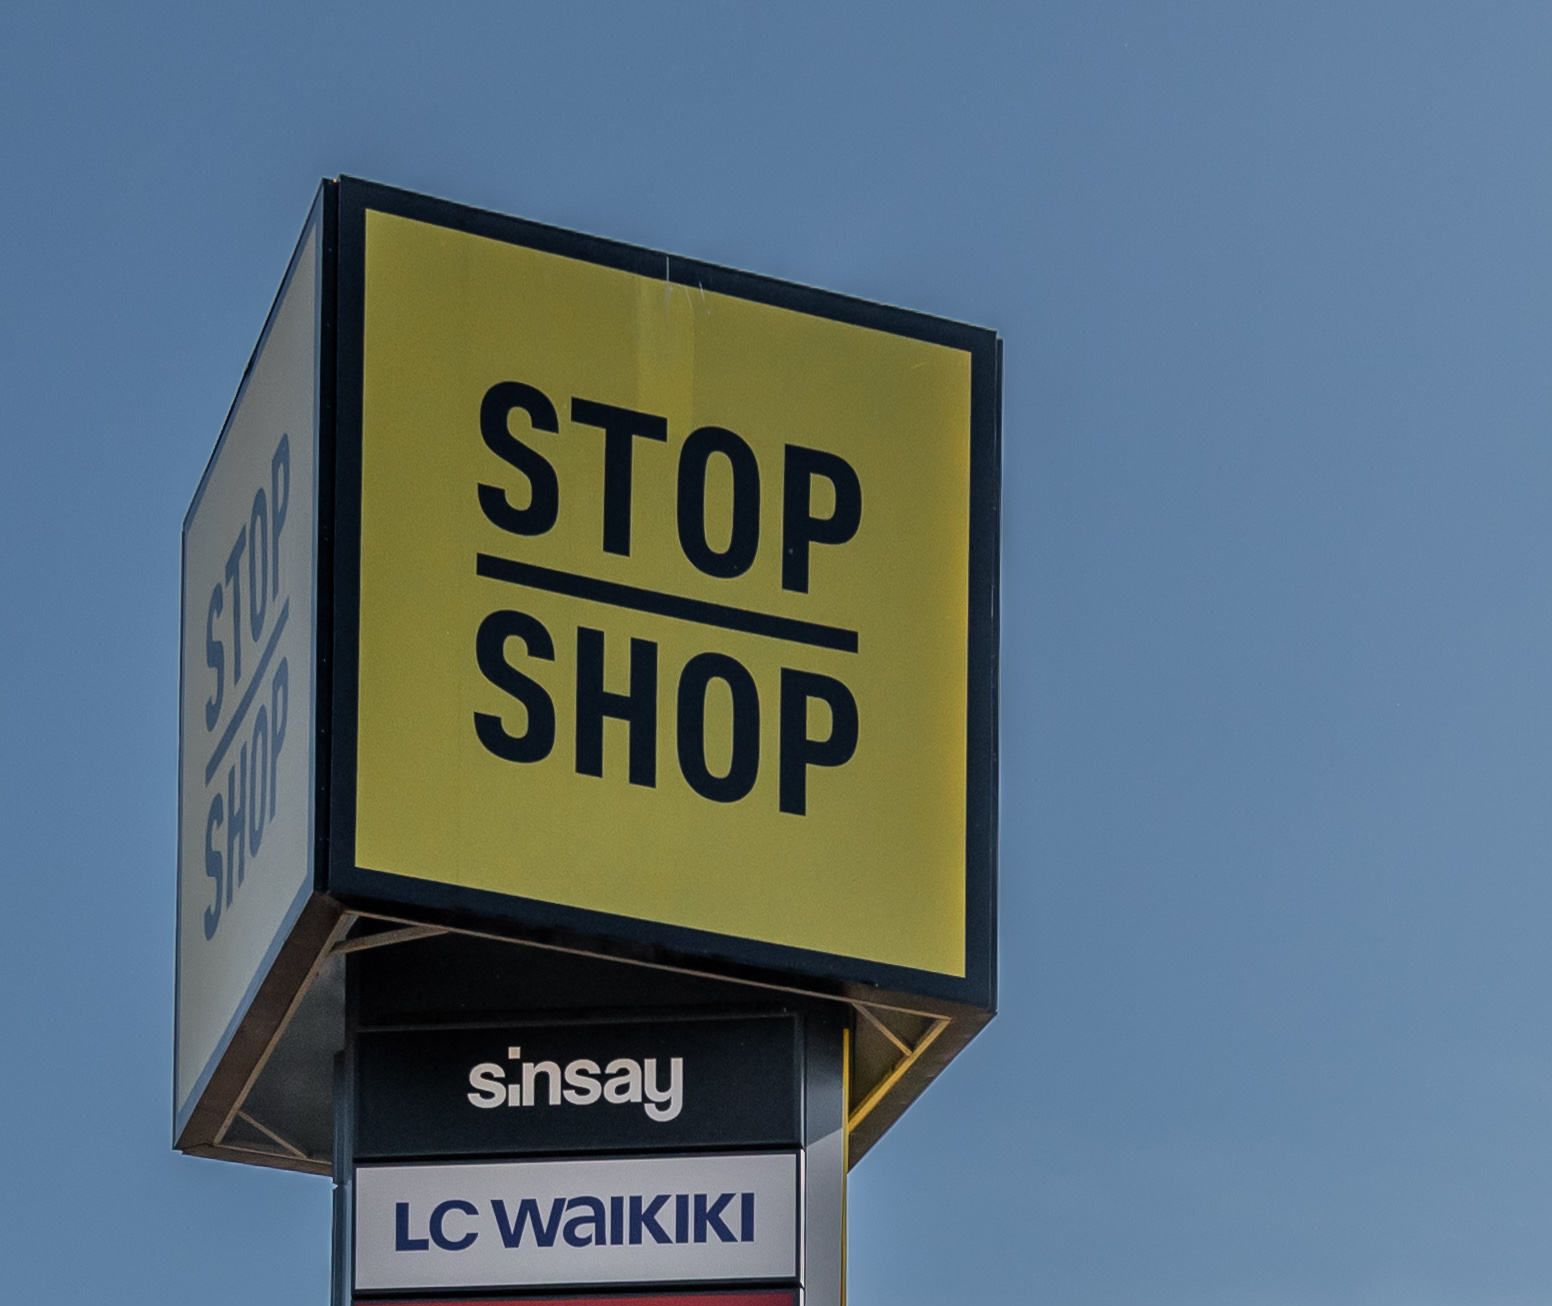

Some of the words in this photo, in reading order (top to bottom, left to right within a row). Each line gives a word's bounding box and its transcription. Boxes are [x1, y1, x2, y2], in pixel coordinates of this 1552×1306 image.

[204, 432, 291, 733] STOP
[476, 380, 863, 595] STOP
[203, 656, 290, 942] SHOP
[473, 608, 860, 818] SHOP
[466, 1046, 684, 1122] sinsay
[394, 1199, 480, 1252] LC
